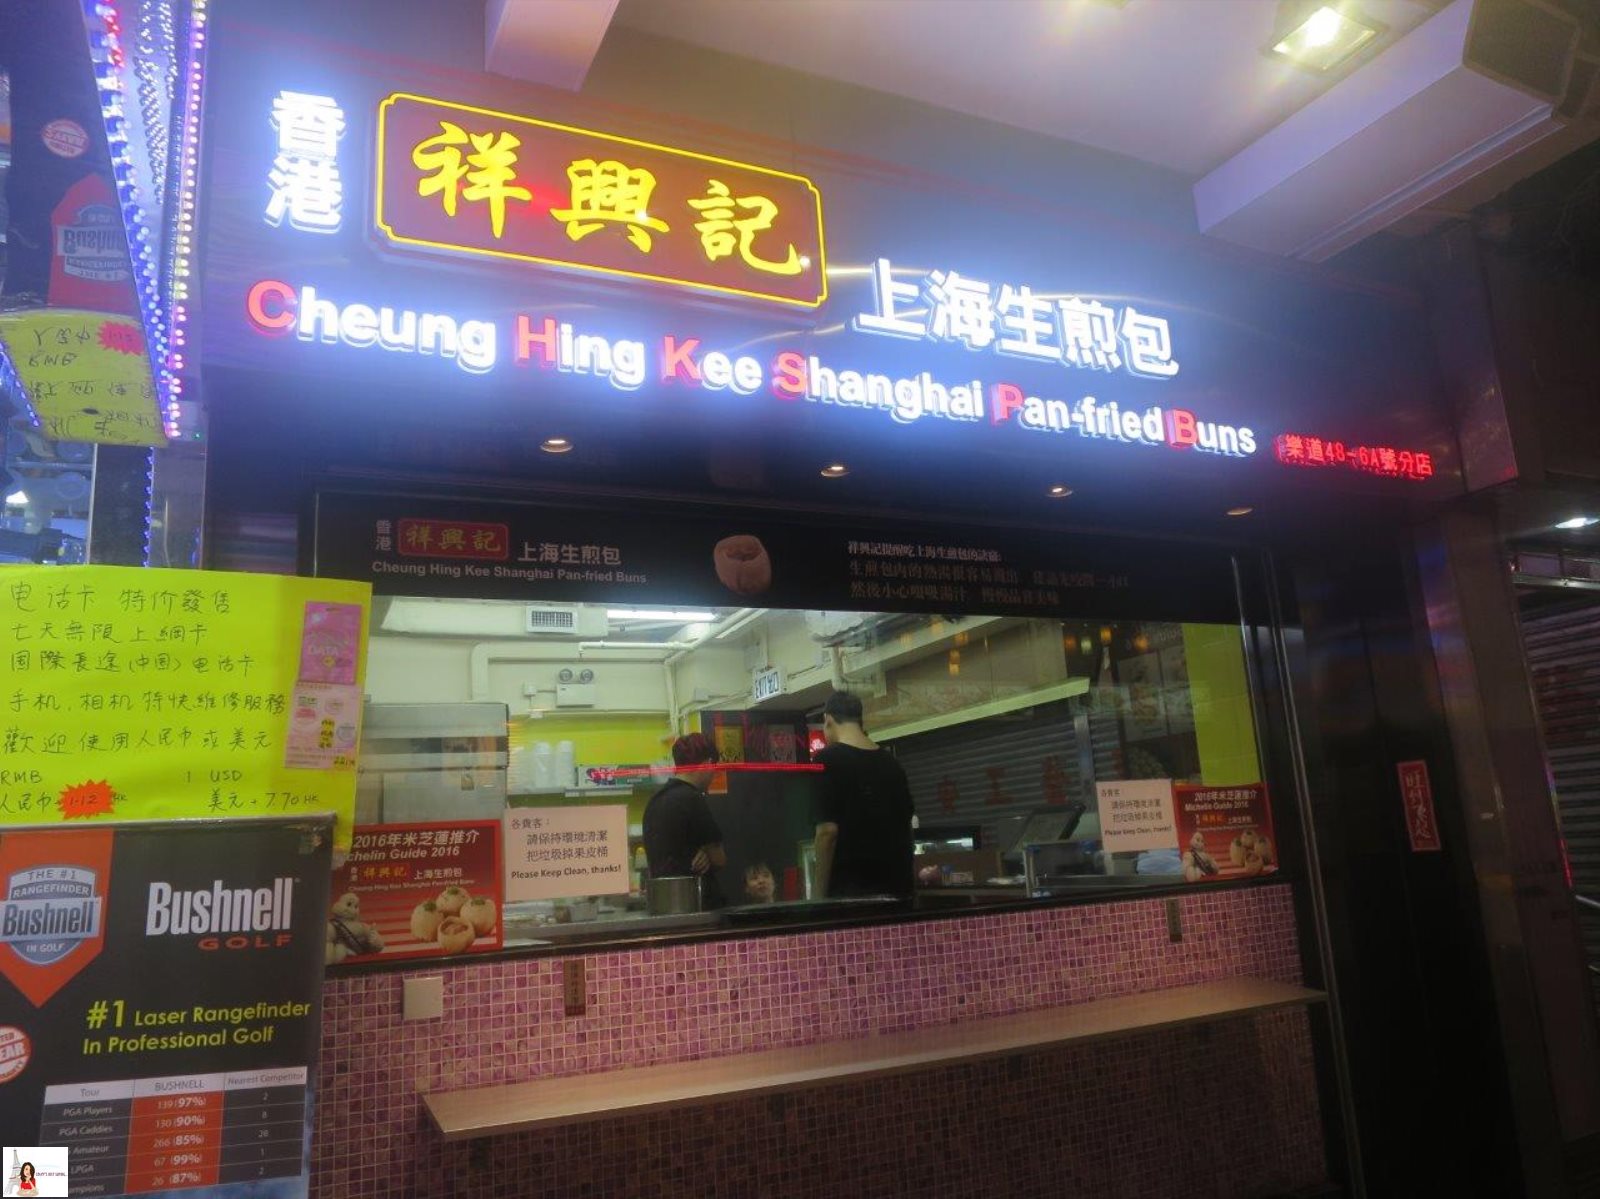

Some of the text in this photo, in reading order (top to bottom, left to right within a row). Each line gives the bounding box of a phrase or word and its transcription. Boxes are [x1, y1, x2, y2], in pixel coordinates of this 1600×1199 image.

[264, 90, 346, 233] 香港
[412, 121, 802, 276] 祥興記
[854, 258, 1179, 378] 上海生煎包
[248, 280, 1257, 456] Cheung Hing Kee Shanghai Pan-fried Buns
[376, 520, 391, 551] 香港
[406, 525, 502, 552] 祥興記
[518, 542, 622, 566] 上海生煎包
[372, 561, 647, 584] Cheung Hing Kee Shanghai Pan-fried Buns
[210, 771, 243, 783] USD
[353, 829, 480, 849] 2016年米芝蓮推介
[390, 847, 427, 860] Guide
[431, 846, 460, 858] 2016
[28, 869, 54, 880] THE
[511, 864, 621, 879] Please Keep Clean, thanks!
[13, 883, 90, 898] RANGEFINDER
[146, 877, 293, 936] Bushnell
[3, 901, 94, 937] Bushnell
[26, 942, 65, 953] IN GOLF
[198, 934, 294, 951] GOLF
[86, 1000, 311, 1029] #1 Laser Rangefinder
[82, 1025, 274, 1054] In Professional Golf
[80, 1072, 304, 1097] Tour BUSHNELL Nearest Competitor
[63, 1108, 82, 1117] PGA
[84, 1106, 113, 1116] Players
[59, 1127, 78, 1136] PGA
[173, 1115, 206, 1127] (90%)
[172, 1135, 204, 1146] (85%)
[70, 1164, 95, 1174] LPGA
[170, 1154, 202, 1165] (99%)
[170, 1173, 200, 1184] (87%)
